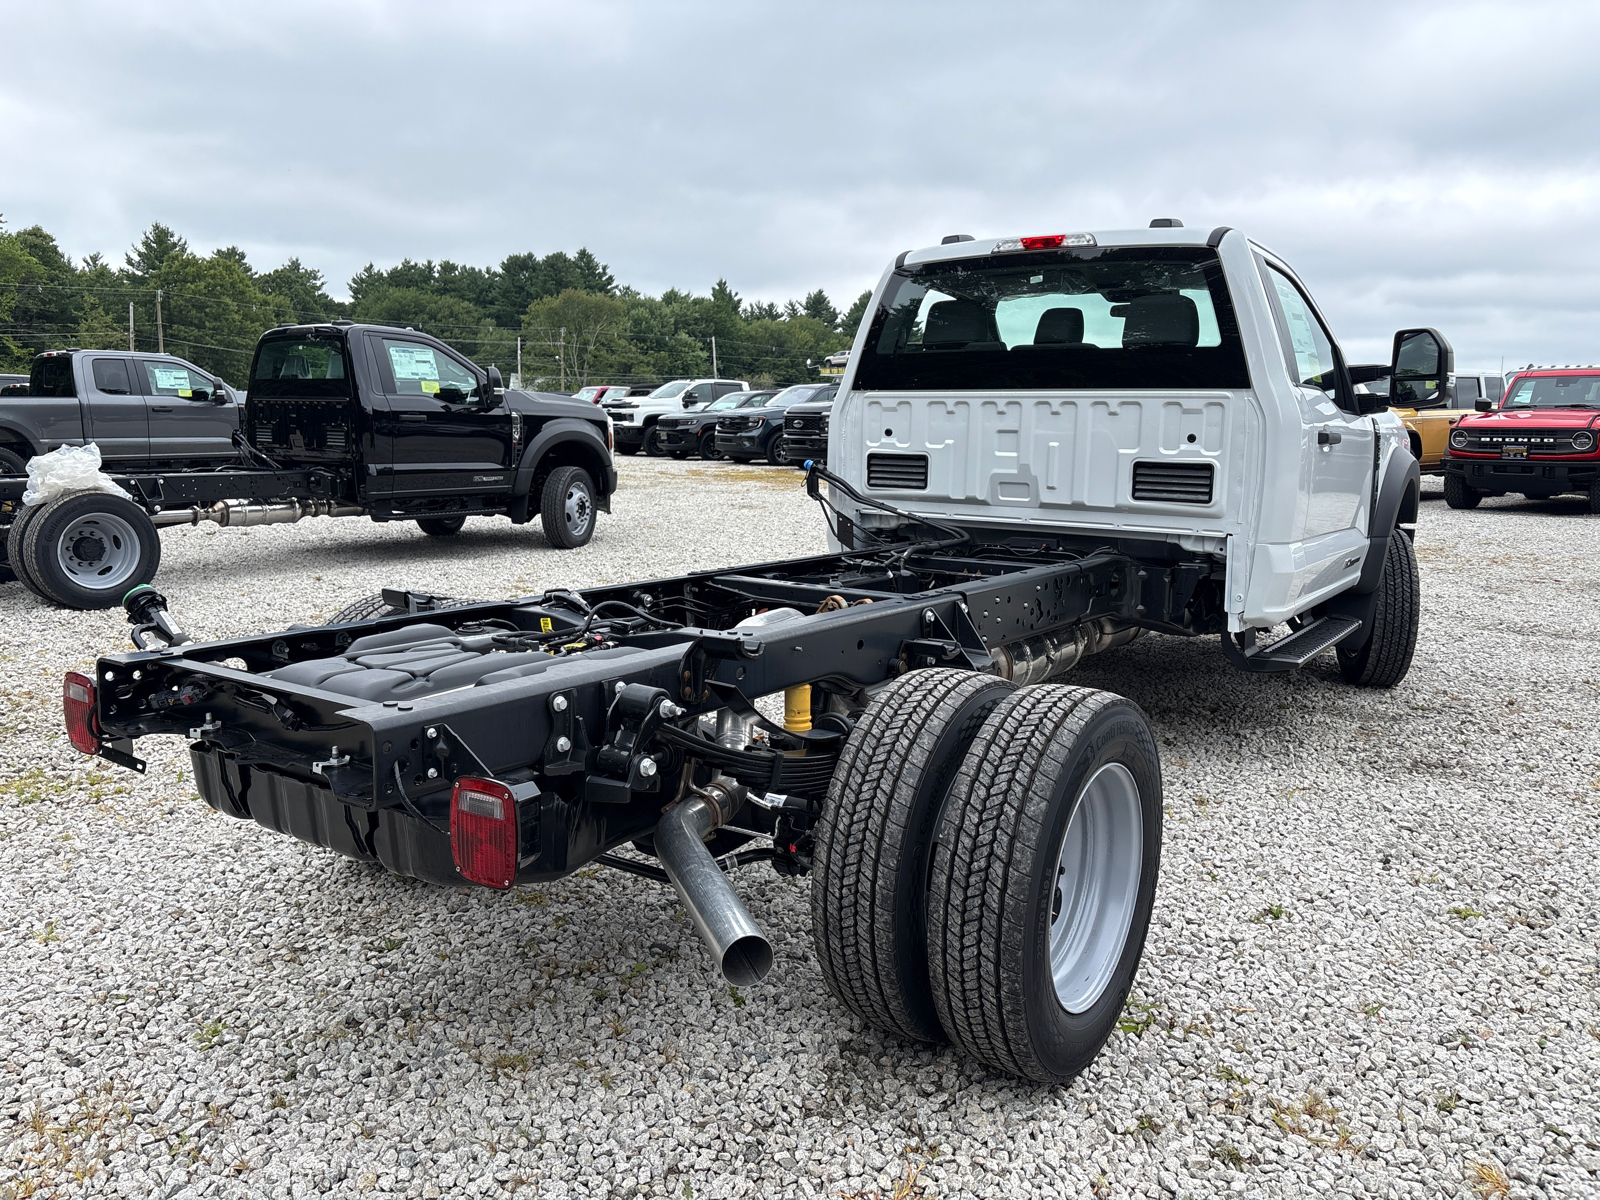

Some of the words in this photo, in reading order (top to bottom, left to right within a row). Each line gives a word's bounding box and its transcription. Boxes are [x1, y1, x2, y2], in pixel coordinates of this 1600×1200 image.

[1096, 723, 1116, 751] Conti
[1040, 898, 1048, 909] R
[1036, 911, 1046, 960] 225/70
